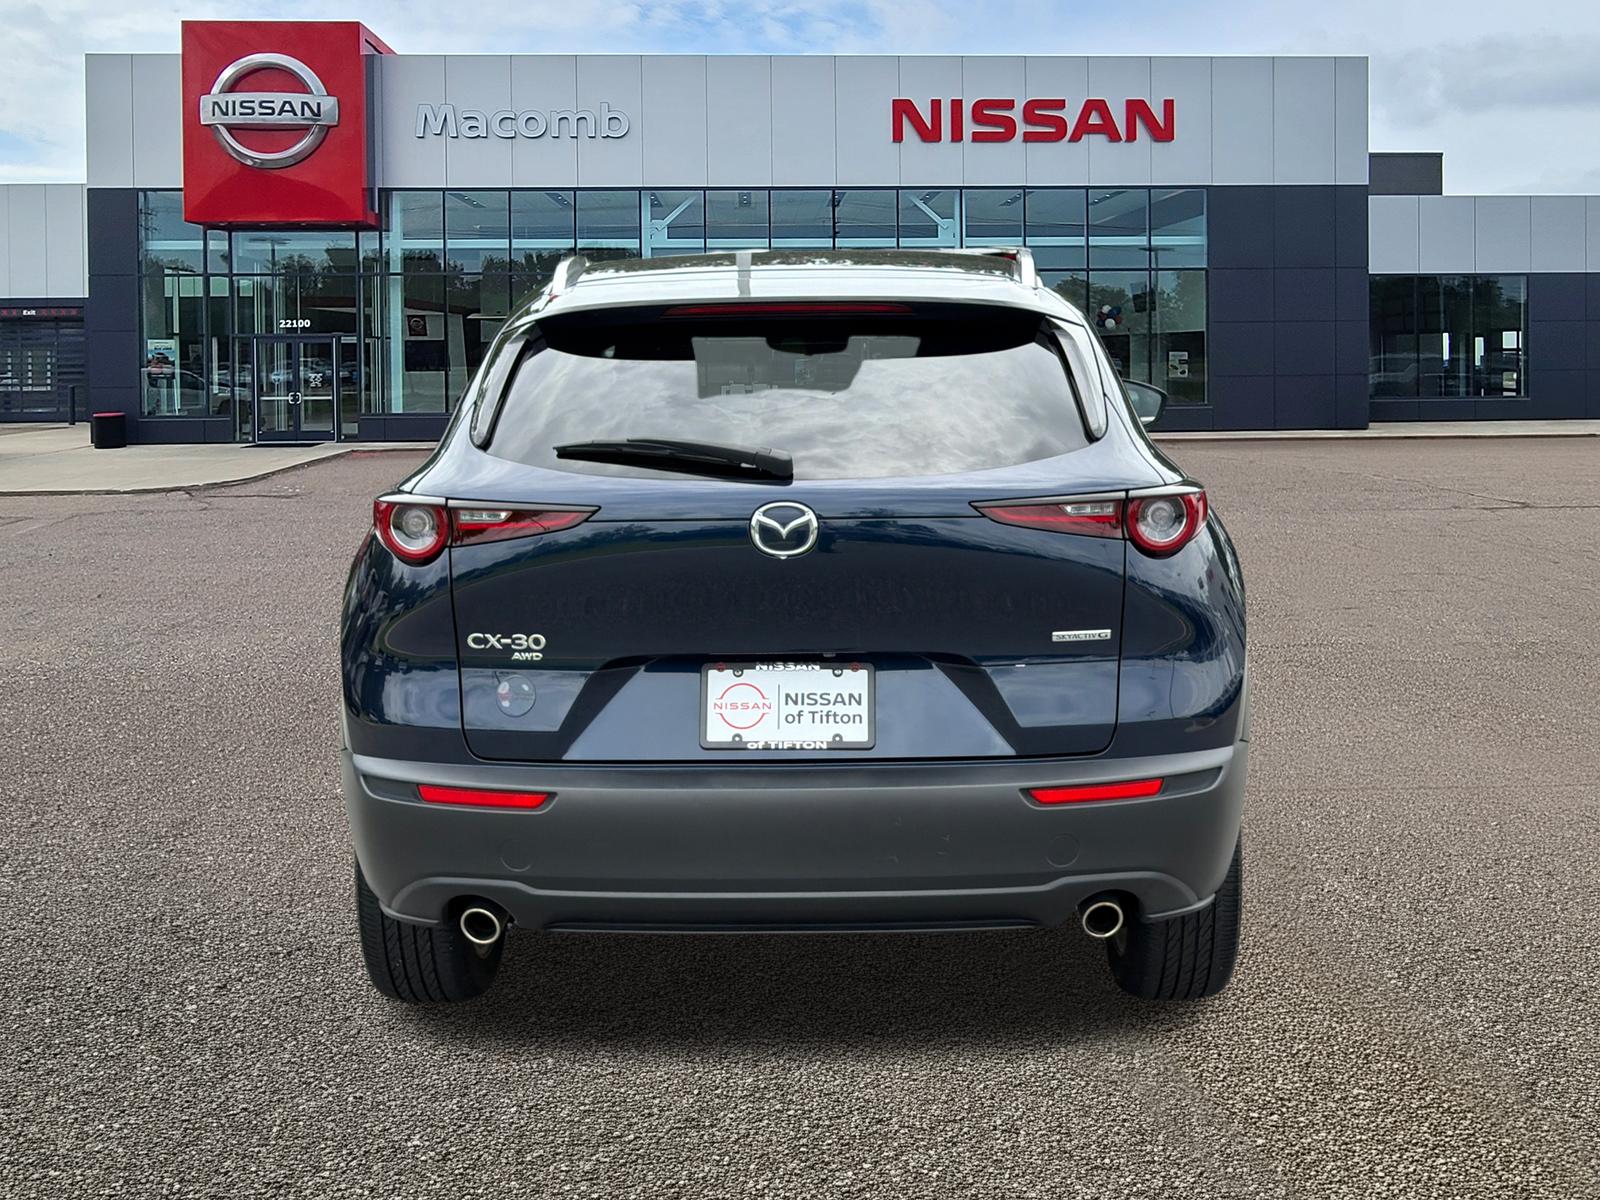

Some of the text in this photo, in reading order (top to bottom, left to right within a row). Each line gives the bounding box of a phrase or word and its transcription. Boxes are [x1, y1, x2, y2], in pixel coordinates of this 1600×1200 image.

[211, 100, 321, 117] NISSAN
[415, 102, 630, 138] Macomb
[893, 98, 1175, 143] NISSAN
[279, 319, 311, 328] 22100
[466, 632, 547, 650] CX-30
[511, 651, 543, 661] AWD
[755, 662, 821, 671] NISSAN
[713, 702, 772, 710] NISSAN
[784, 692, 862, 706] NISSAN
[784, 710, 863, 724] of Tifton
[766, 741, 828, 749] TIFTON
